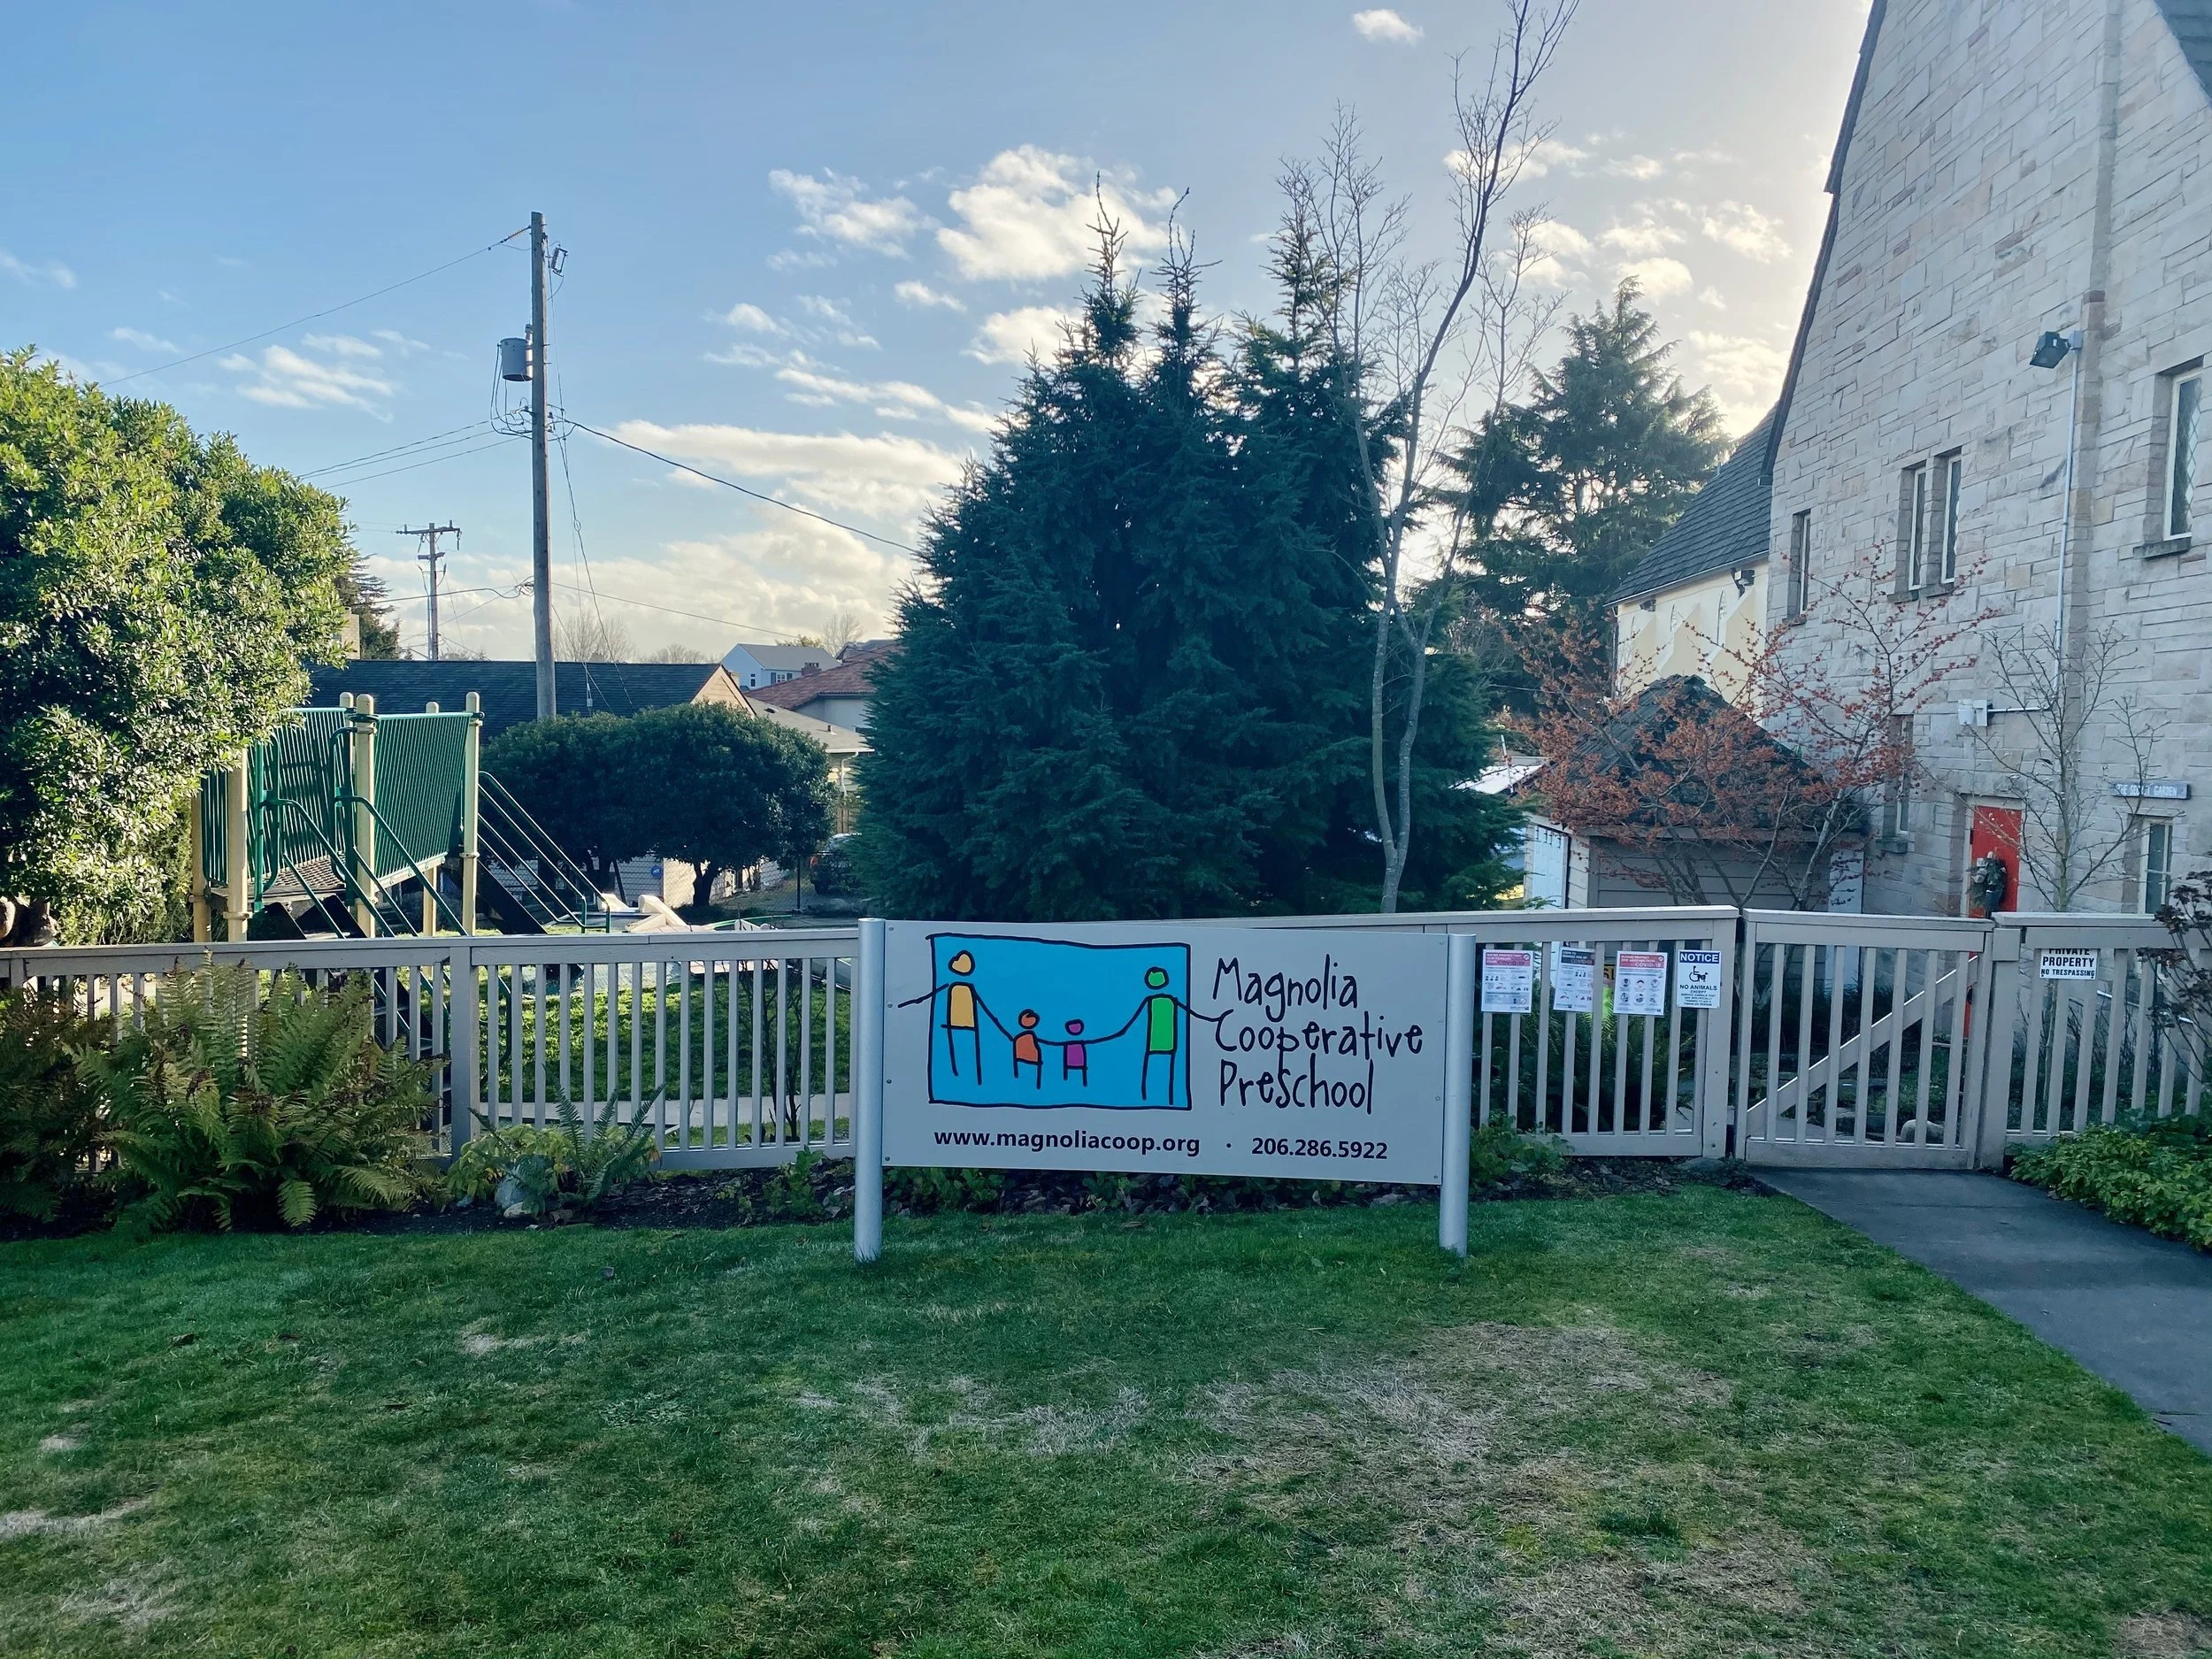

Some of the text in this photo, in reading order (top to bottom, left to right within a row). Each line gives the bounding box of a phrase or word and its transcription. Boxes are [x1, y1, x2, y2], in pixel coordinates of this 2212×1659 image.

[2154, 785, 2177, 796] GARDEN
[1680, 953, 1719, 963] NOTICE
[2042, 956, 2095, 967] PROPERTY
[1212, 953, 1358, 1023] Magnolia
[1215, 1008, 1424, 1069] Cooperative
[1220, 1052, 1374, 1116] Preschool
[933, 1129, 1388, 1160] www.magnoliacoop.org 206.286.5922
